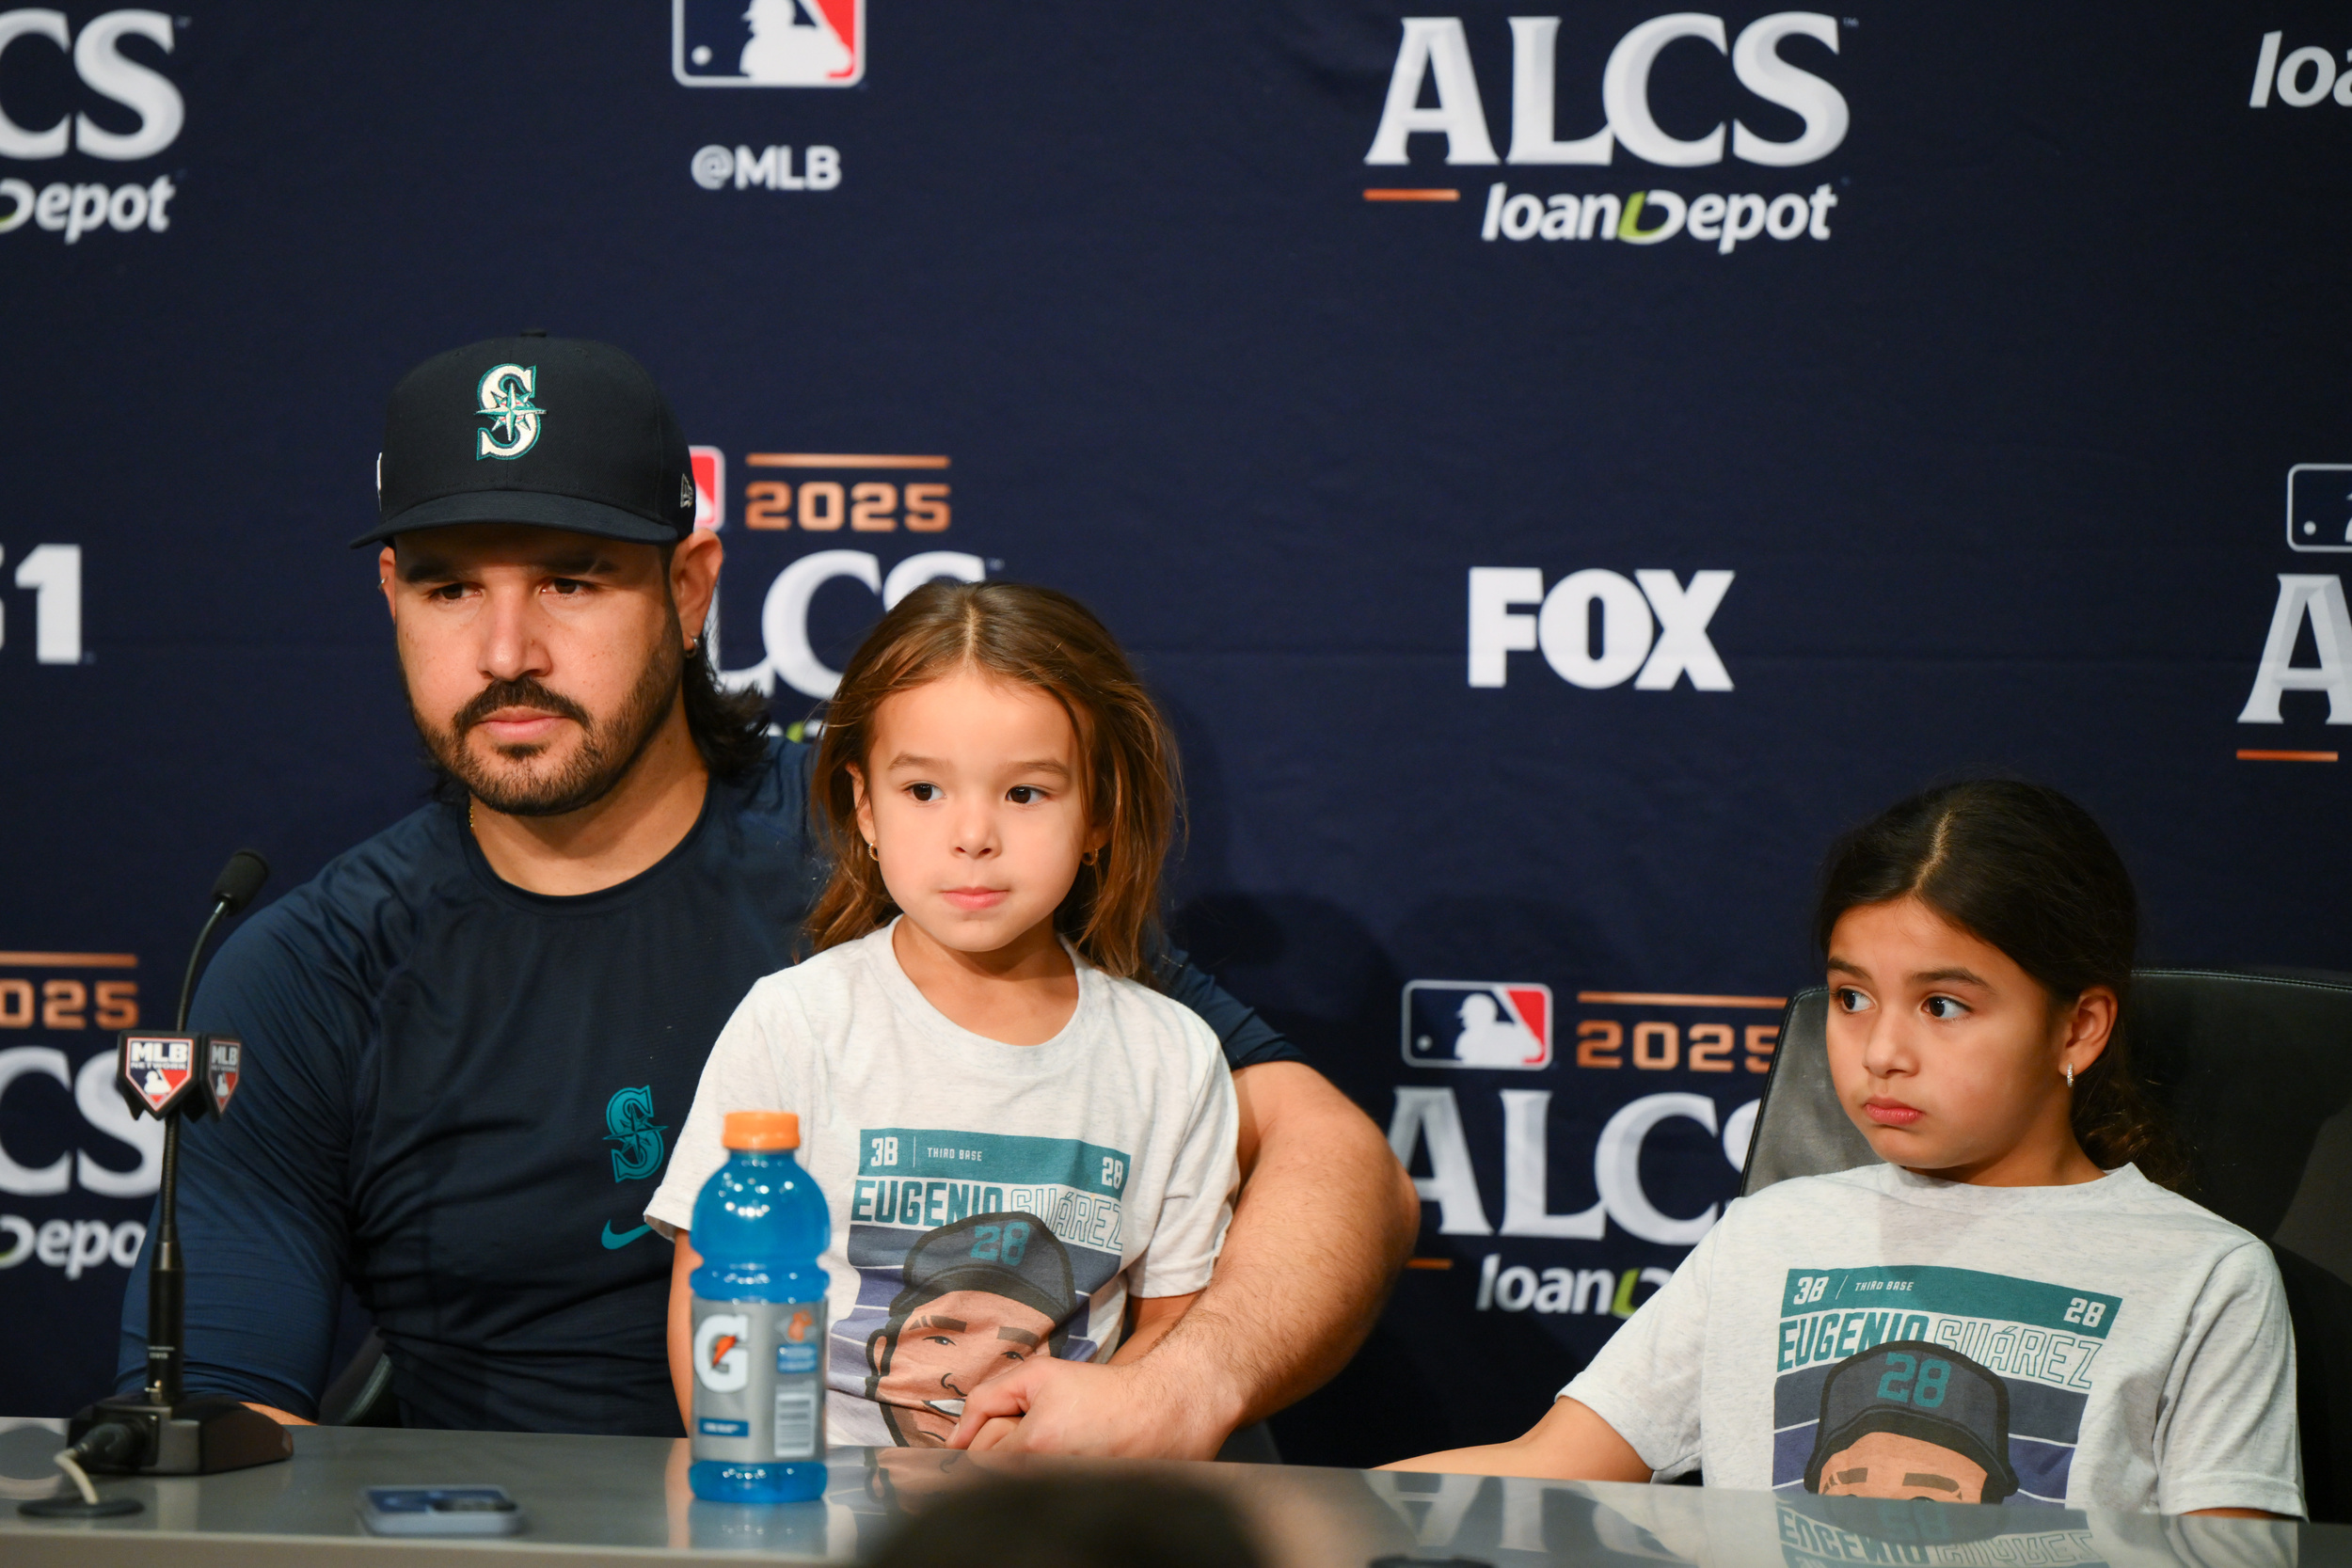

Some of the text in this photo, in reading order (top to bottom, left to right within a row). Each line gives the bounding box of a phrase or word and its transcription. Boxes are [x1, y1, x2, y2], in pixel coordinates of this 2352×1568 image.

[1363, 11, 1850, 168] ALCS
[691, 144, 842, 191] @MLB
[1481, 182, 1837, 255] loanDepot
[477, 363, 541, 461] S
[746, 481, 952, 532] 2025
[1468, 566, 1736, 691] FOX
[131, 1042, 188, 1063] MLB
[131, 1062, 187, 1070] NETWORK
[211, 1045, 238, 1066] MLB
[1577, 1020, 1781, 1074] 2025
[606, 1085, 664, 1183] S
[870, 1136, 1123, 1189] 3B THIRD BASE 28
[850, 1180, 1004, 1227] EUGENIO
[970, 1221, 1030, 1266] 28
[1793, 1275, 2106, 1327] 3B THIRD BASE 28
[693, 1313, 749, 1393] G
[1776, 1311, 1930, 1373] EUGENIO
[1877, 1352, 1951, 1408] 28
